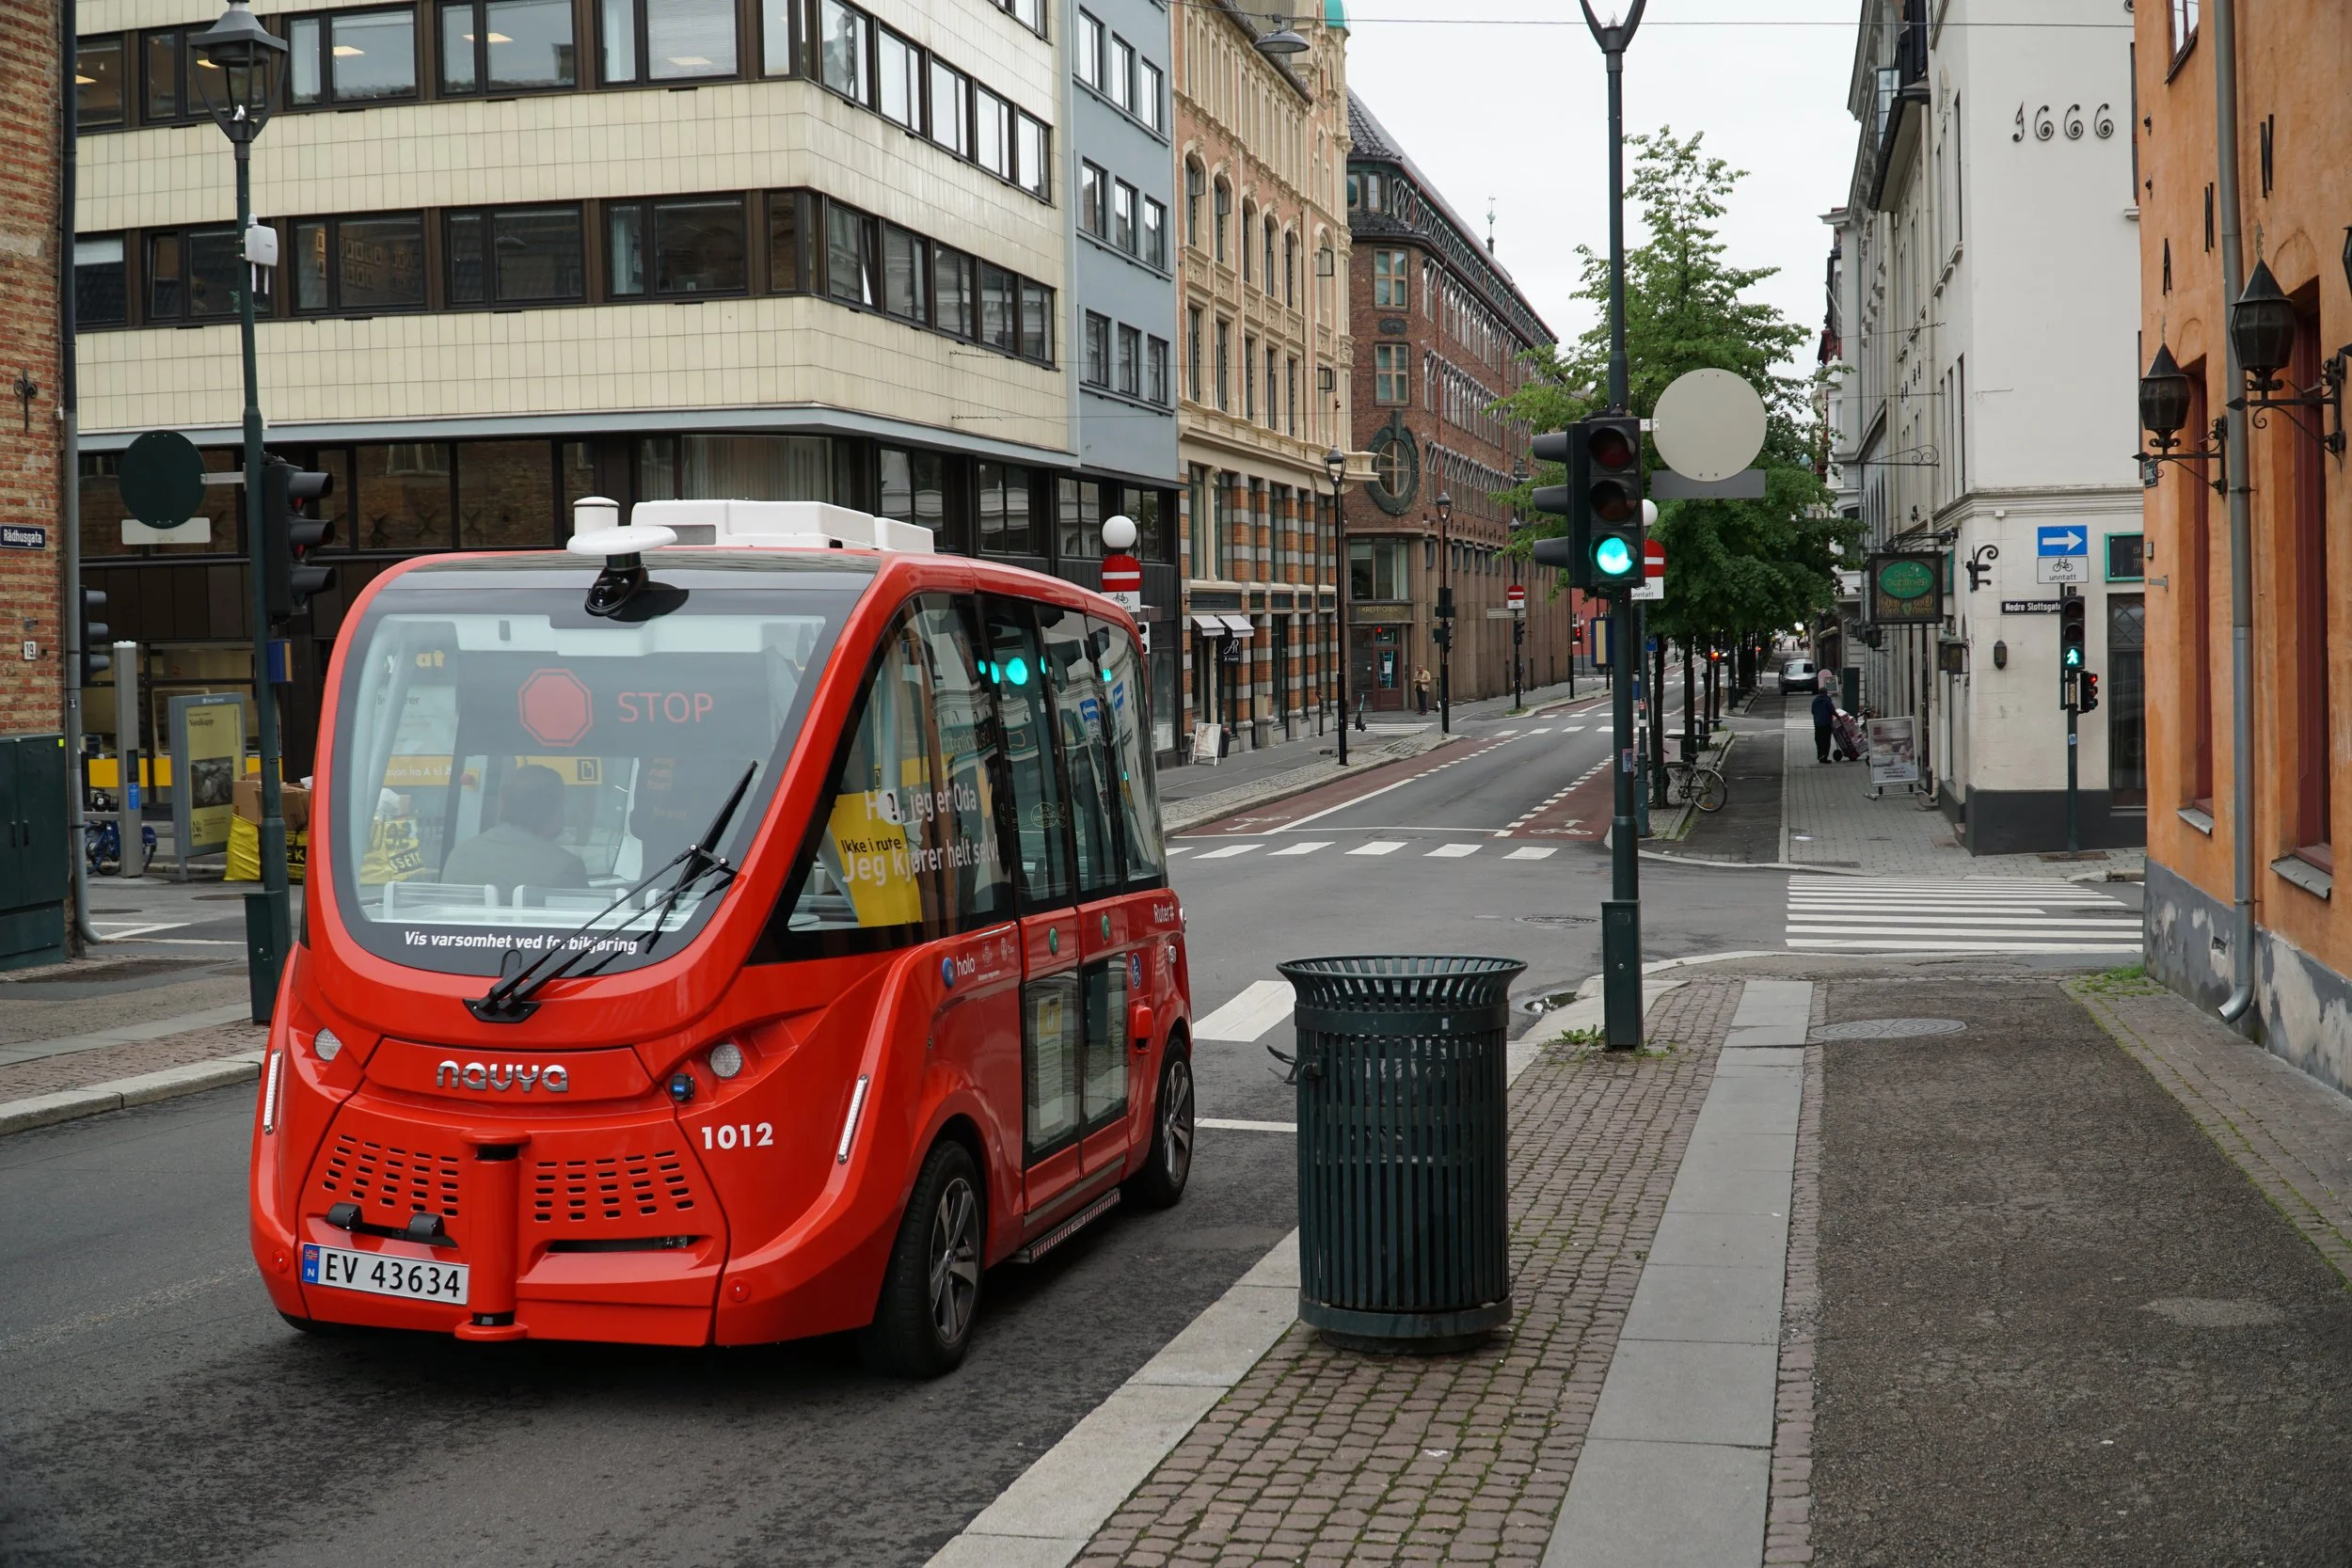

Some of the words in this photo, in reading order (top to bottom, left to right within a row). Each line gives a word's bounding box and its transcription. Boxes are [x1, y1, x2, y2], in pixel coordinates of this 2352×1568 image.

[2012, 101, 2115, 143] 1666
[4, 529, 42, 546] Rådhusgata
[2005, 603, 2026, 611] Nedre
[26, 643, 34, 657] 19
[617, 691, 714, 723] STOP
[953, 782, 977, 812] Oda
[841, 839, 867, 854] Ikke
[876, 836, 903, 851] rute
[842, 850, 886, 887] Jeg
[946, 838, 972, 868] helt
[405, 930, 427, 946] Vis
[431, 932, 513, 949] varsomhet
[516, 935, 542, 950] ved
[956, 953, 977, 978] holo
[436, 1059, 569, 1093] navya
[701, 1122, 773, 1149] 1012
[326, 1253, 359, 1284] EV
[371, 1259, 460, 1298] 43634
